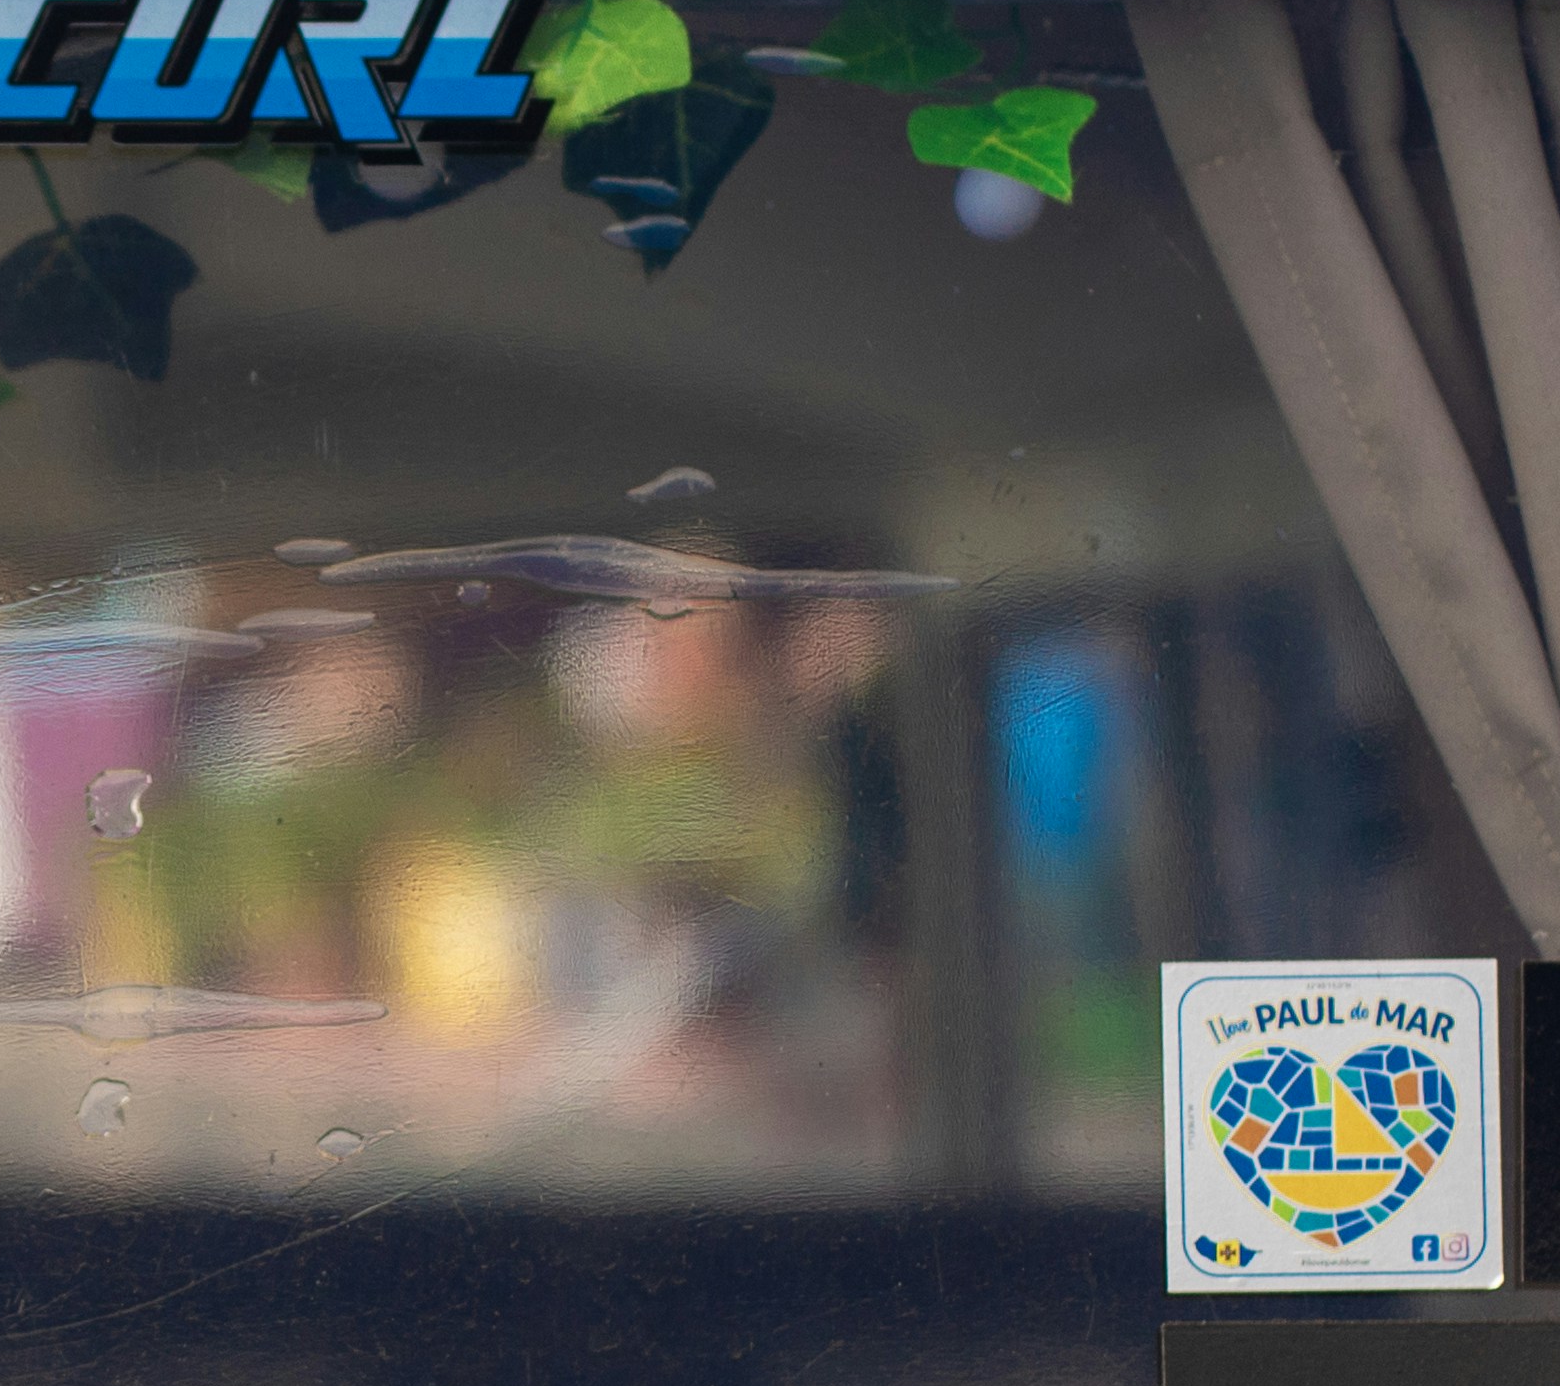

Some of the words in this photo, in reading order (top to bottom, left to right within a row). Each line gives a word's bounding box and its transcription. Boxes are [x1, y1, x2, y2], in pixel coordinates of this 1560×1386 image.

[1220, 1016, 1251, 1040] love
[1255, 996, 1345, 1033] PAUL
[1375, 999, 1456, 1043] MAR
